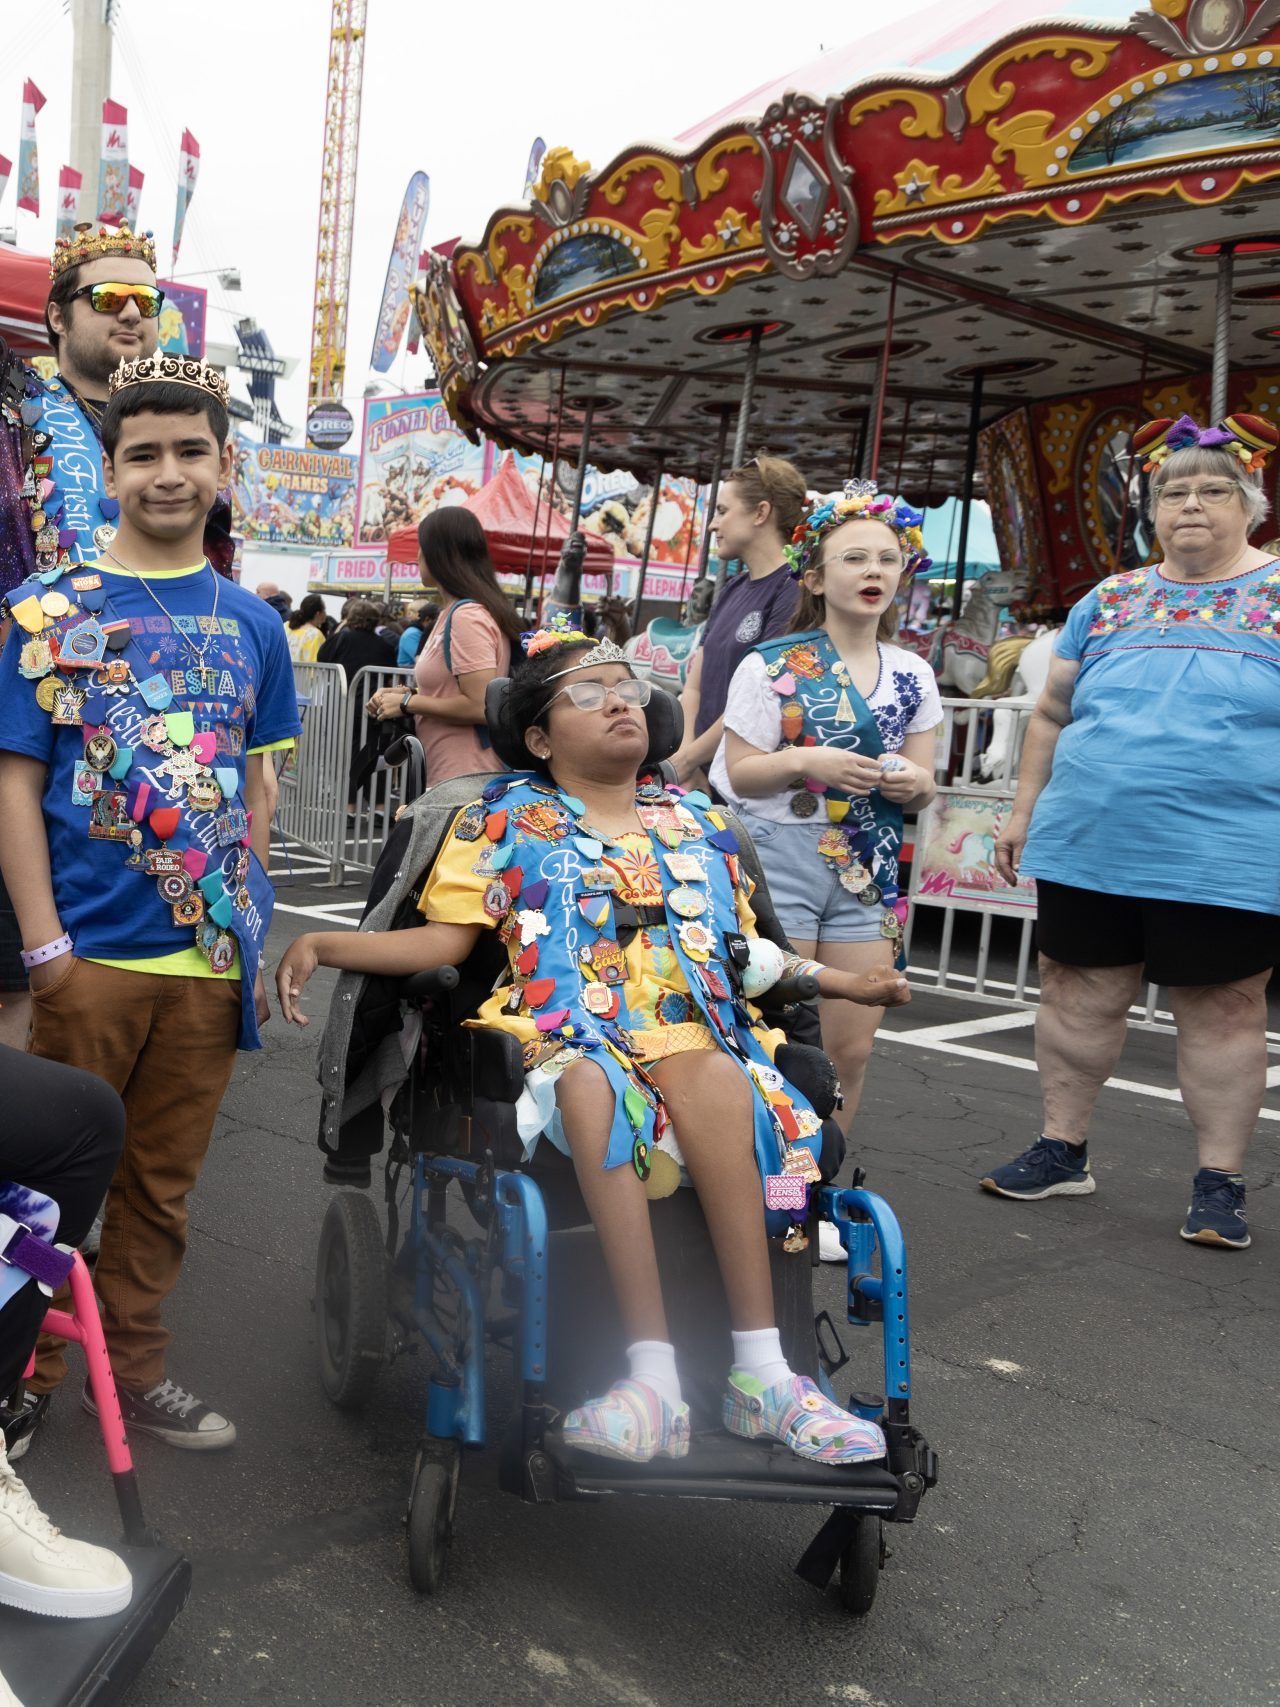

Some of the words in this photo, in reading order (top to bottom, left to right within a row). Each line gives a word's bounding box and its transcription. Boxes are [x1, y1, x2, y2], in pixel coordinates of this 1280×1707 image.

[308, 419, 353, 433] OREOS
[369, 408, 428, 452] FUNNEL
[258, 447, 353, 481] CARNIVAL
[57, 451, 99, 531] Fiesta
[281, 474, 329, 494] GAMES
[337, 560, 376, 578] FRIED
[642, 577, 693, 600] ELEPHAN
[163, 669, 237, 698] ESTA
[592, 950, 626, 973] Easy
